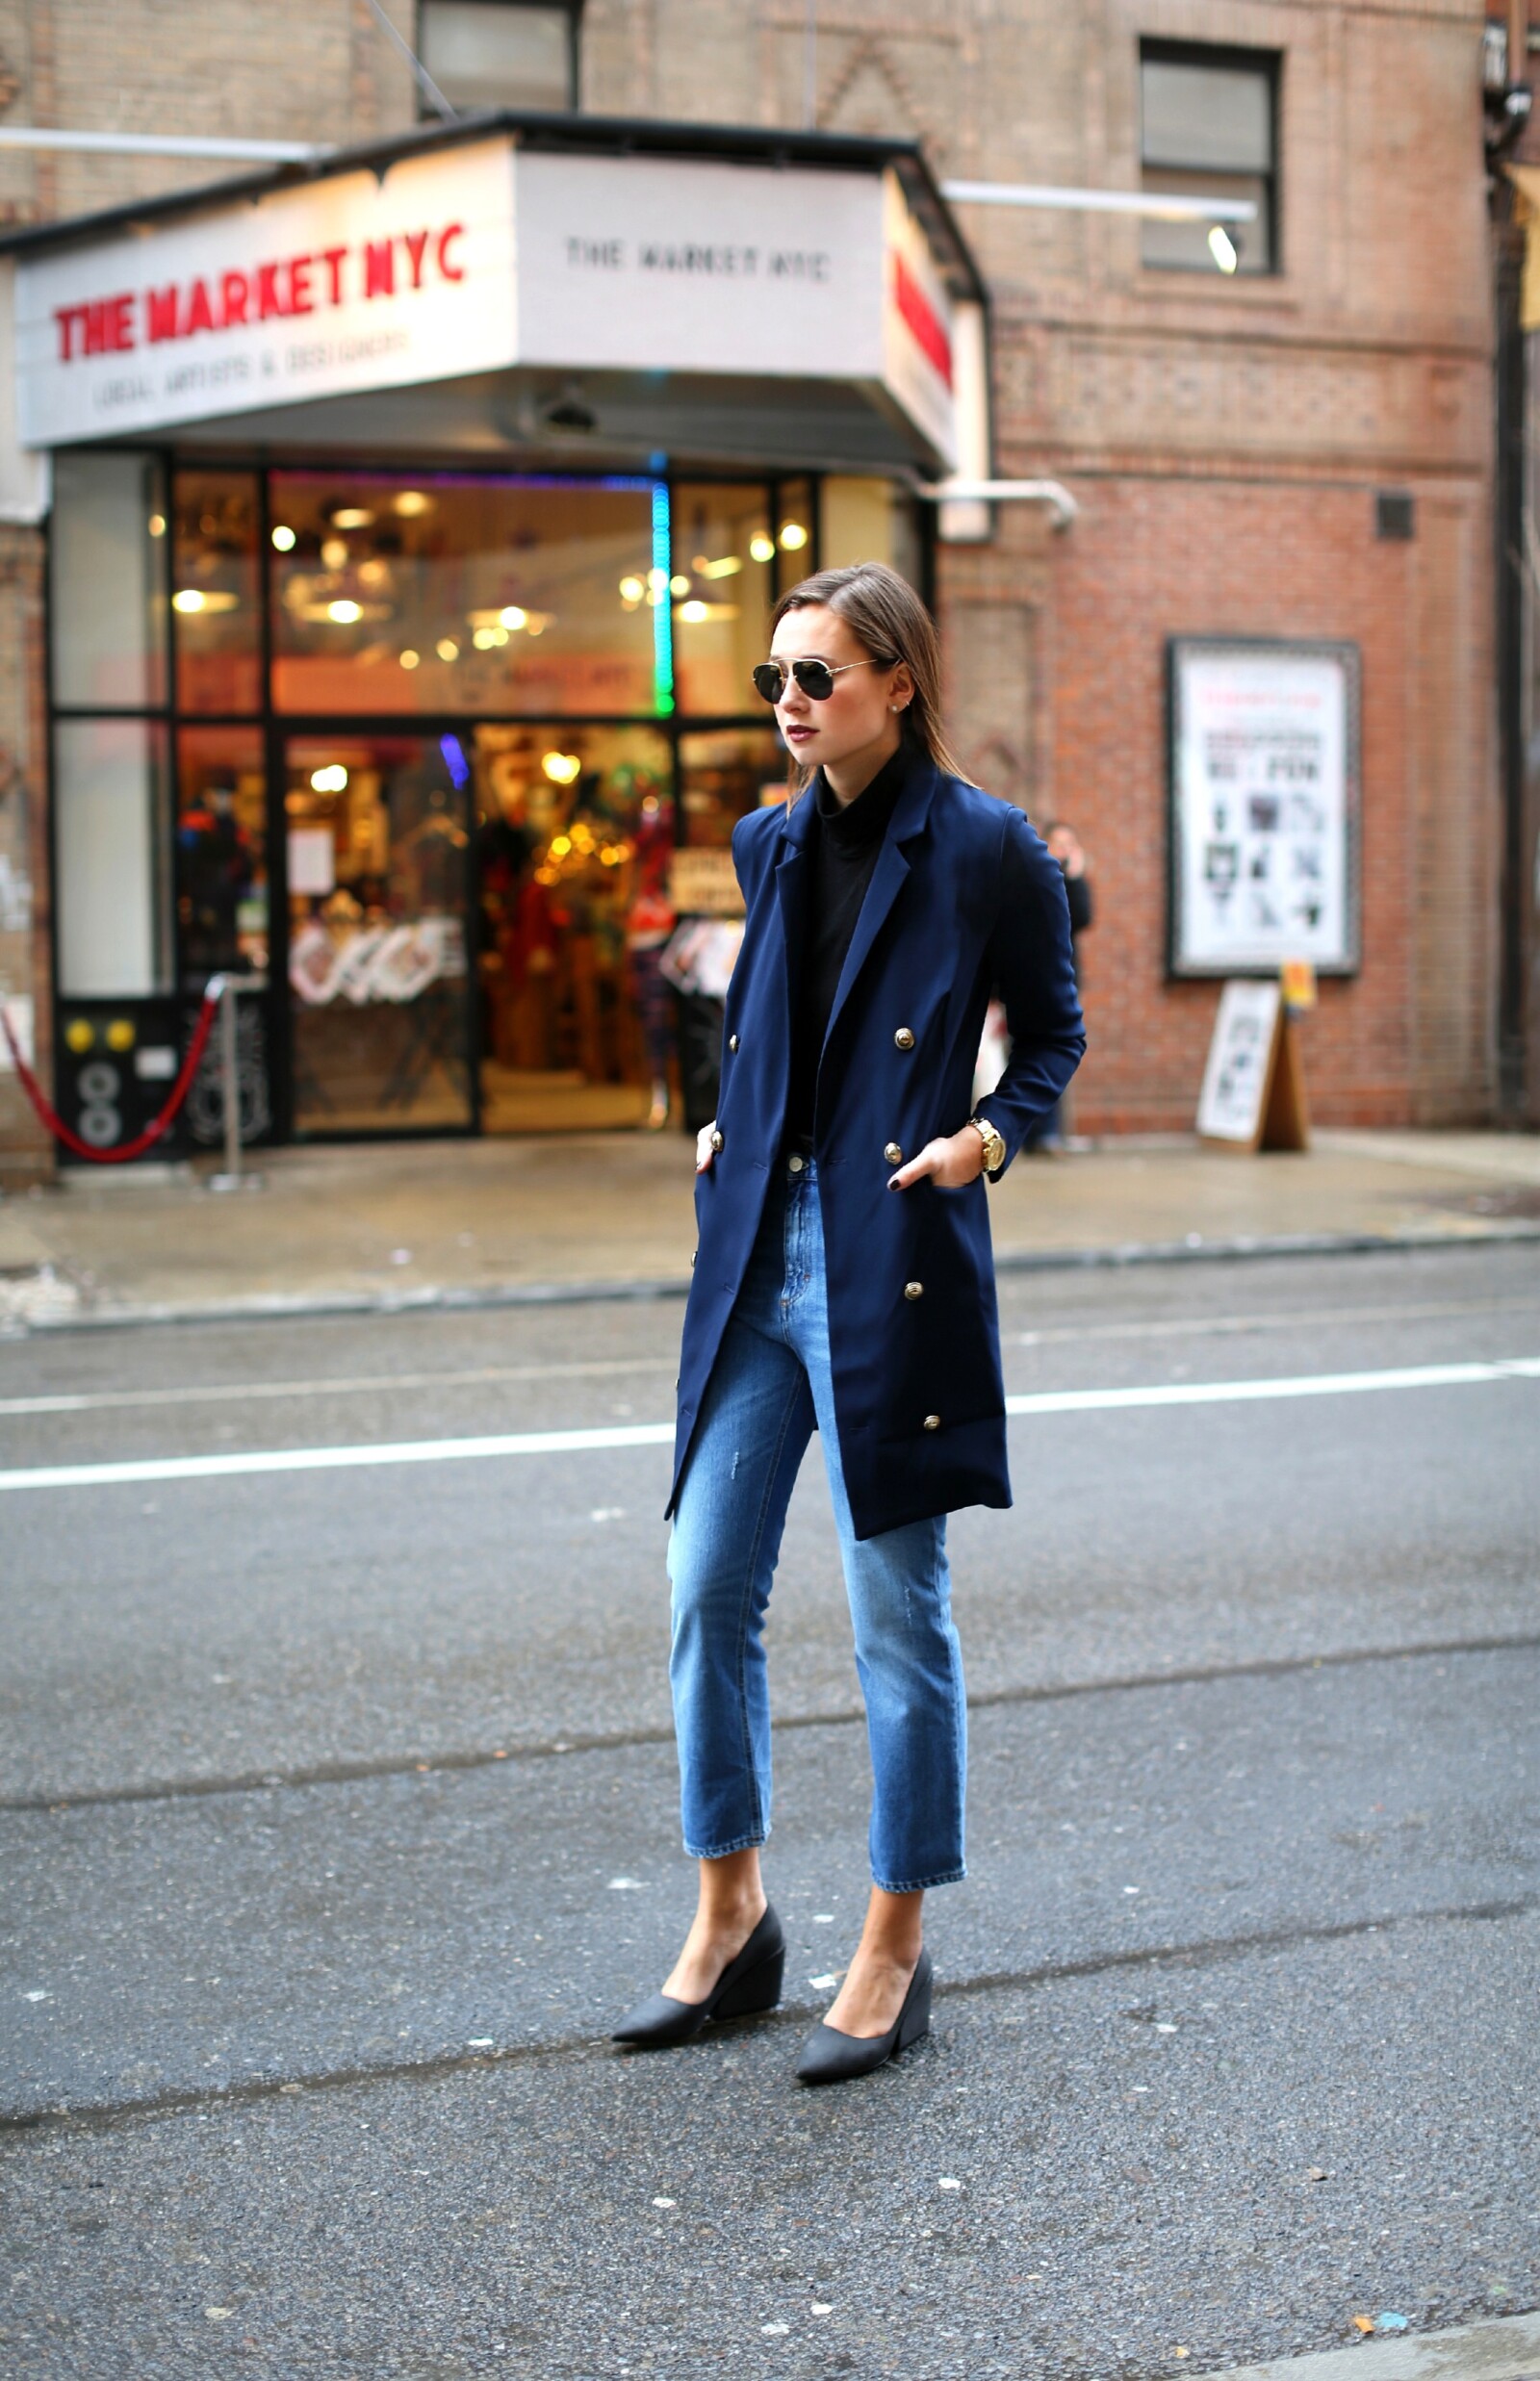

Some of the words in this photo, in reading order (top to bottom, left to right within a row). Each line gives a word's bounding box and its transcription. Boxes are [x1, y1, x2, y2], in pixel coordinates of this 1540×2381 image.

[55, 294, 136, 362] THE
[146, 245, 349, 344] MARKET
[363, 222, 465, 300] NYC
[565, 237, 626, 270] THE
[637, 242, 758, 274] MARKET
